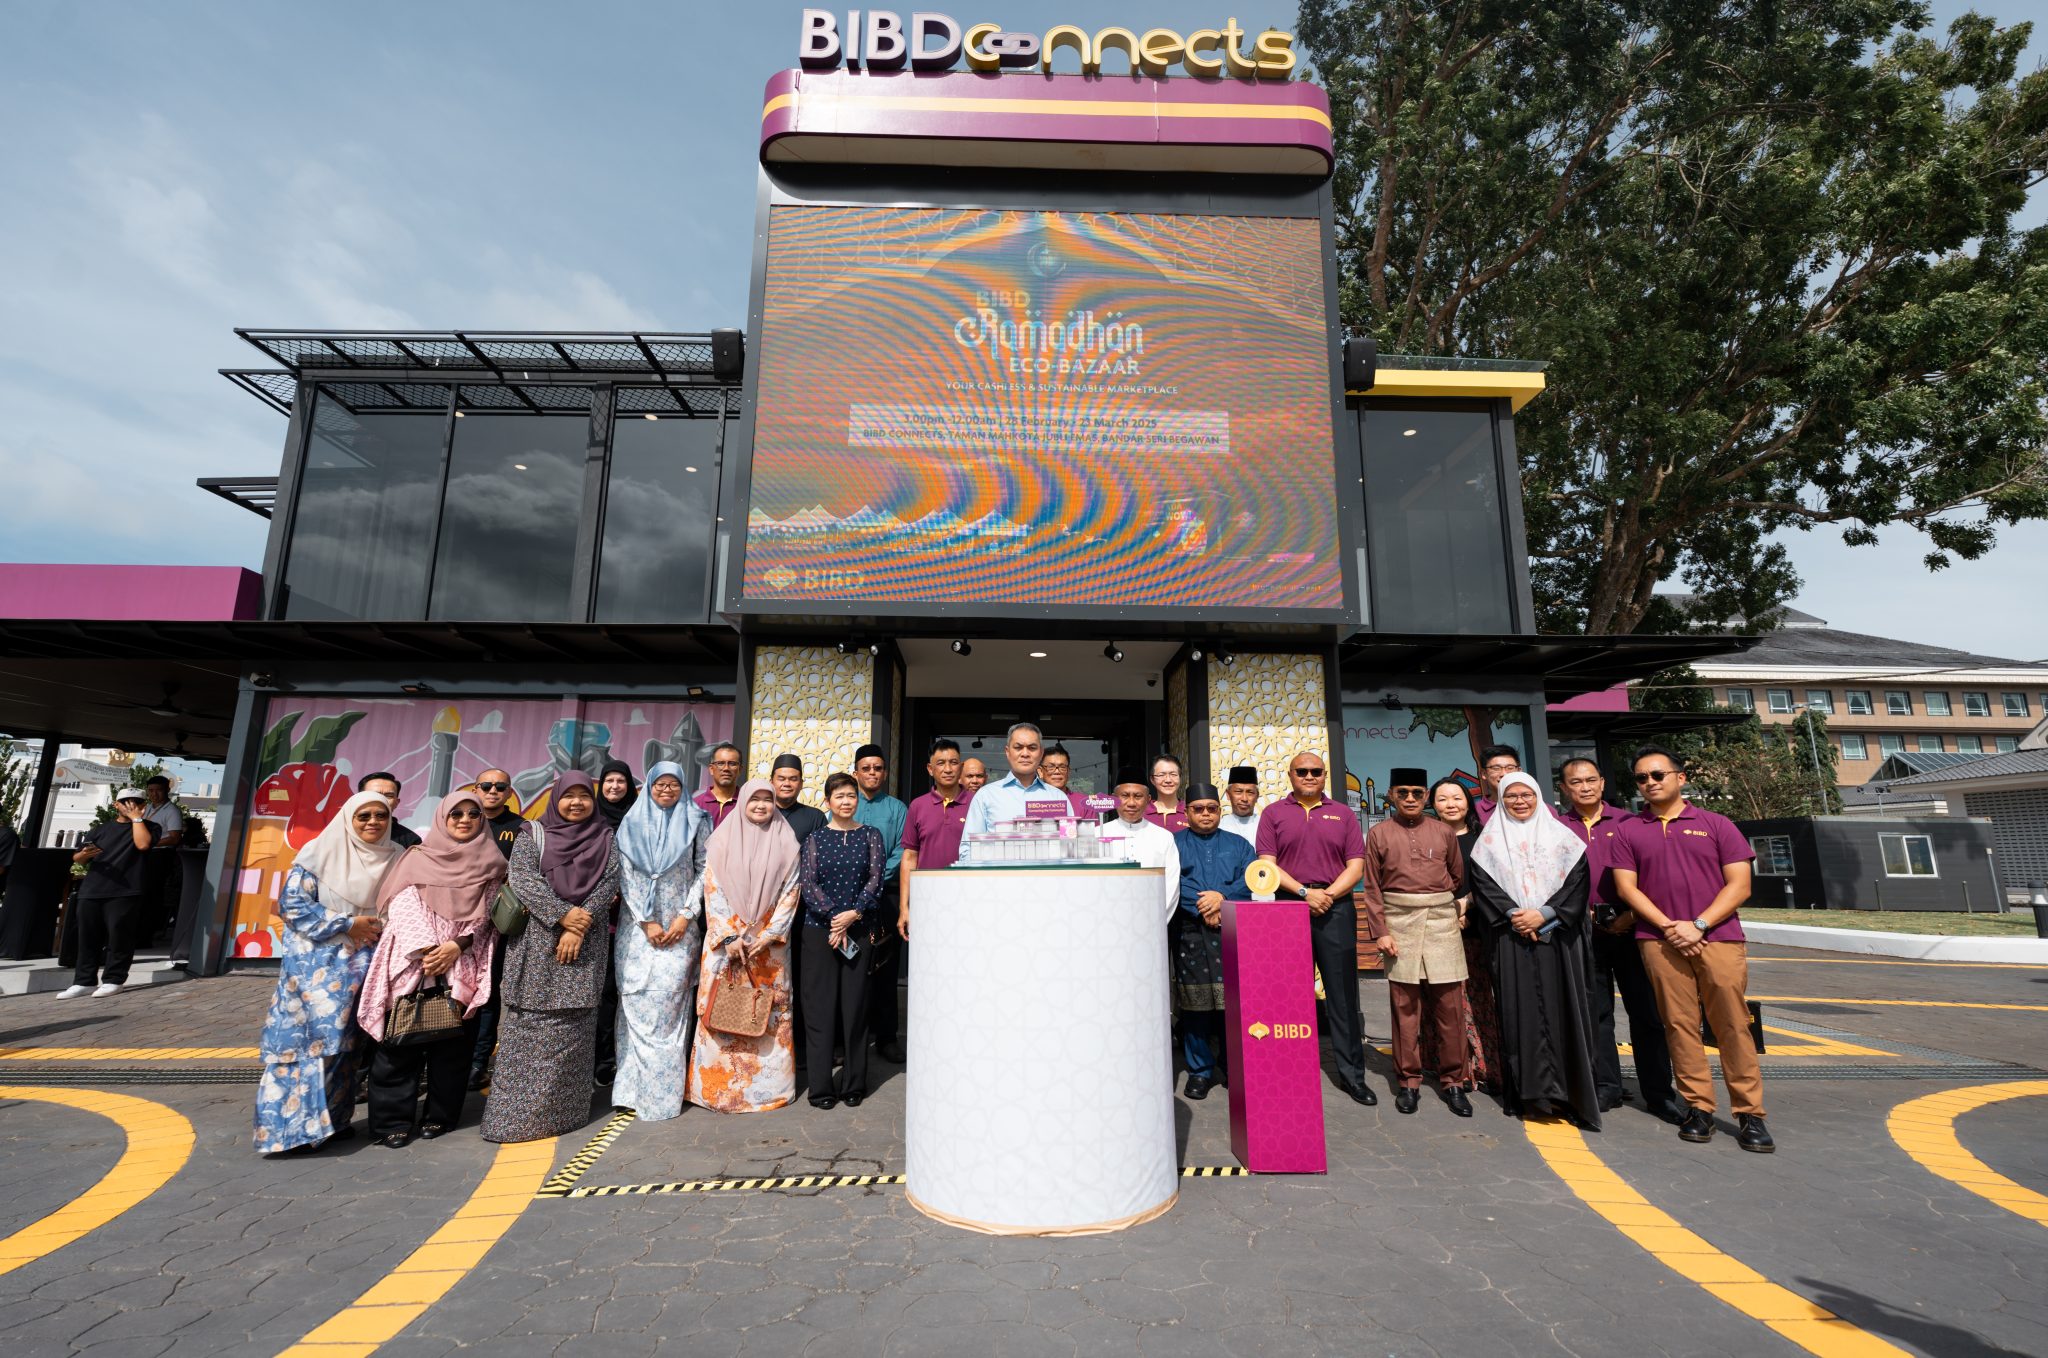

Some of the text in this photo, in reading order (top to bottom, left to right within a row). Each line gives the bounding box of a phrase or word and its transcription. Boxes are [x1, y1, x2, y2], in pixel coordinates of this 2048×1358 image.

[976, 290, 1031, 308] BIBD
[1009, 357, 1141, 375] ECO-BAZAAR
[946, 381, 1179, 395] YOUR CASHLESS & SUSTAINABLE MARKETPLACE
[1021, 416, 1069, 429] February
[1094, 418, 1129, 428] March
[1132, 418, 1157, 429] 2025
[863, 429, 886, 438] BIBD
[949, 431, 986, 440] TAMAN
[988, 431, 1039, 441] MAHKOTA
[1102, 433, 1144, 443] BANDAR
[1146, 434, 1167, 444] SERI
[1169, 435, 1220, 445] BEGAWAN
[804, 569, 864, 590] BIBD
[1343, 724, 1408, 740] nnects
[1274, 1024, 1312, 1039] BIBD
